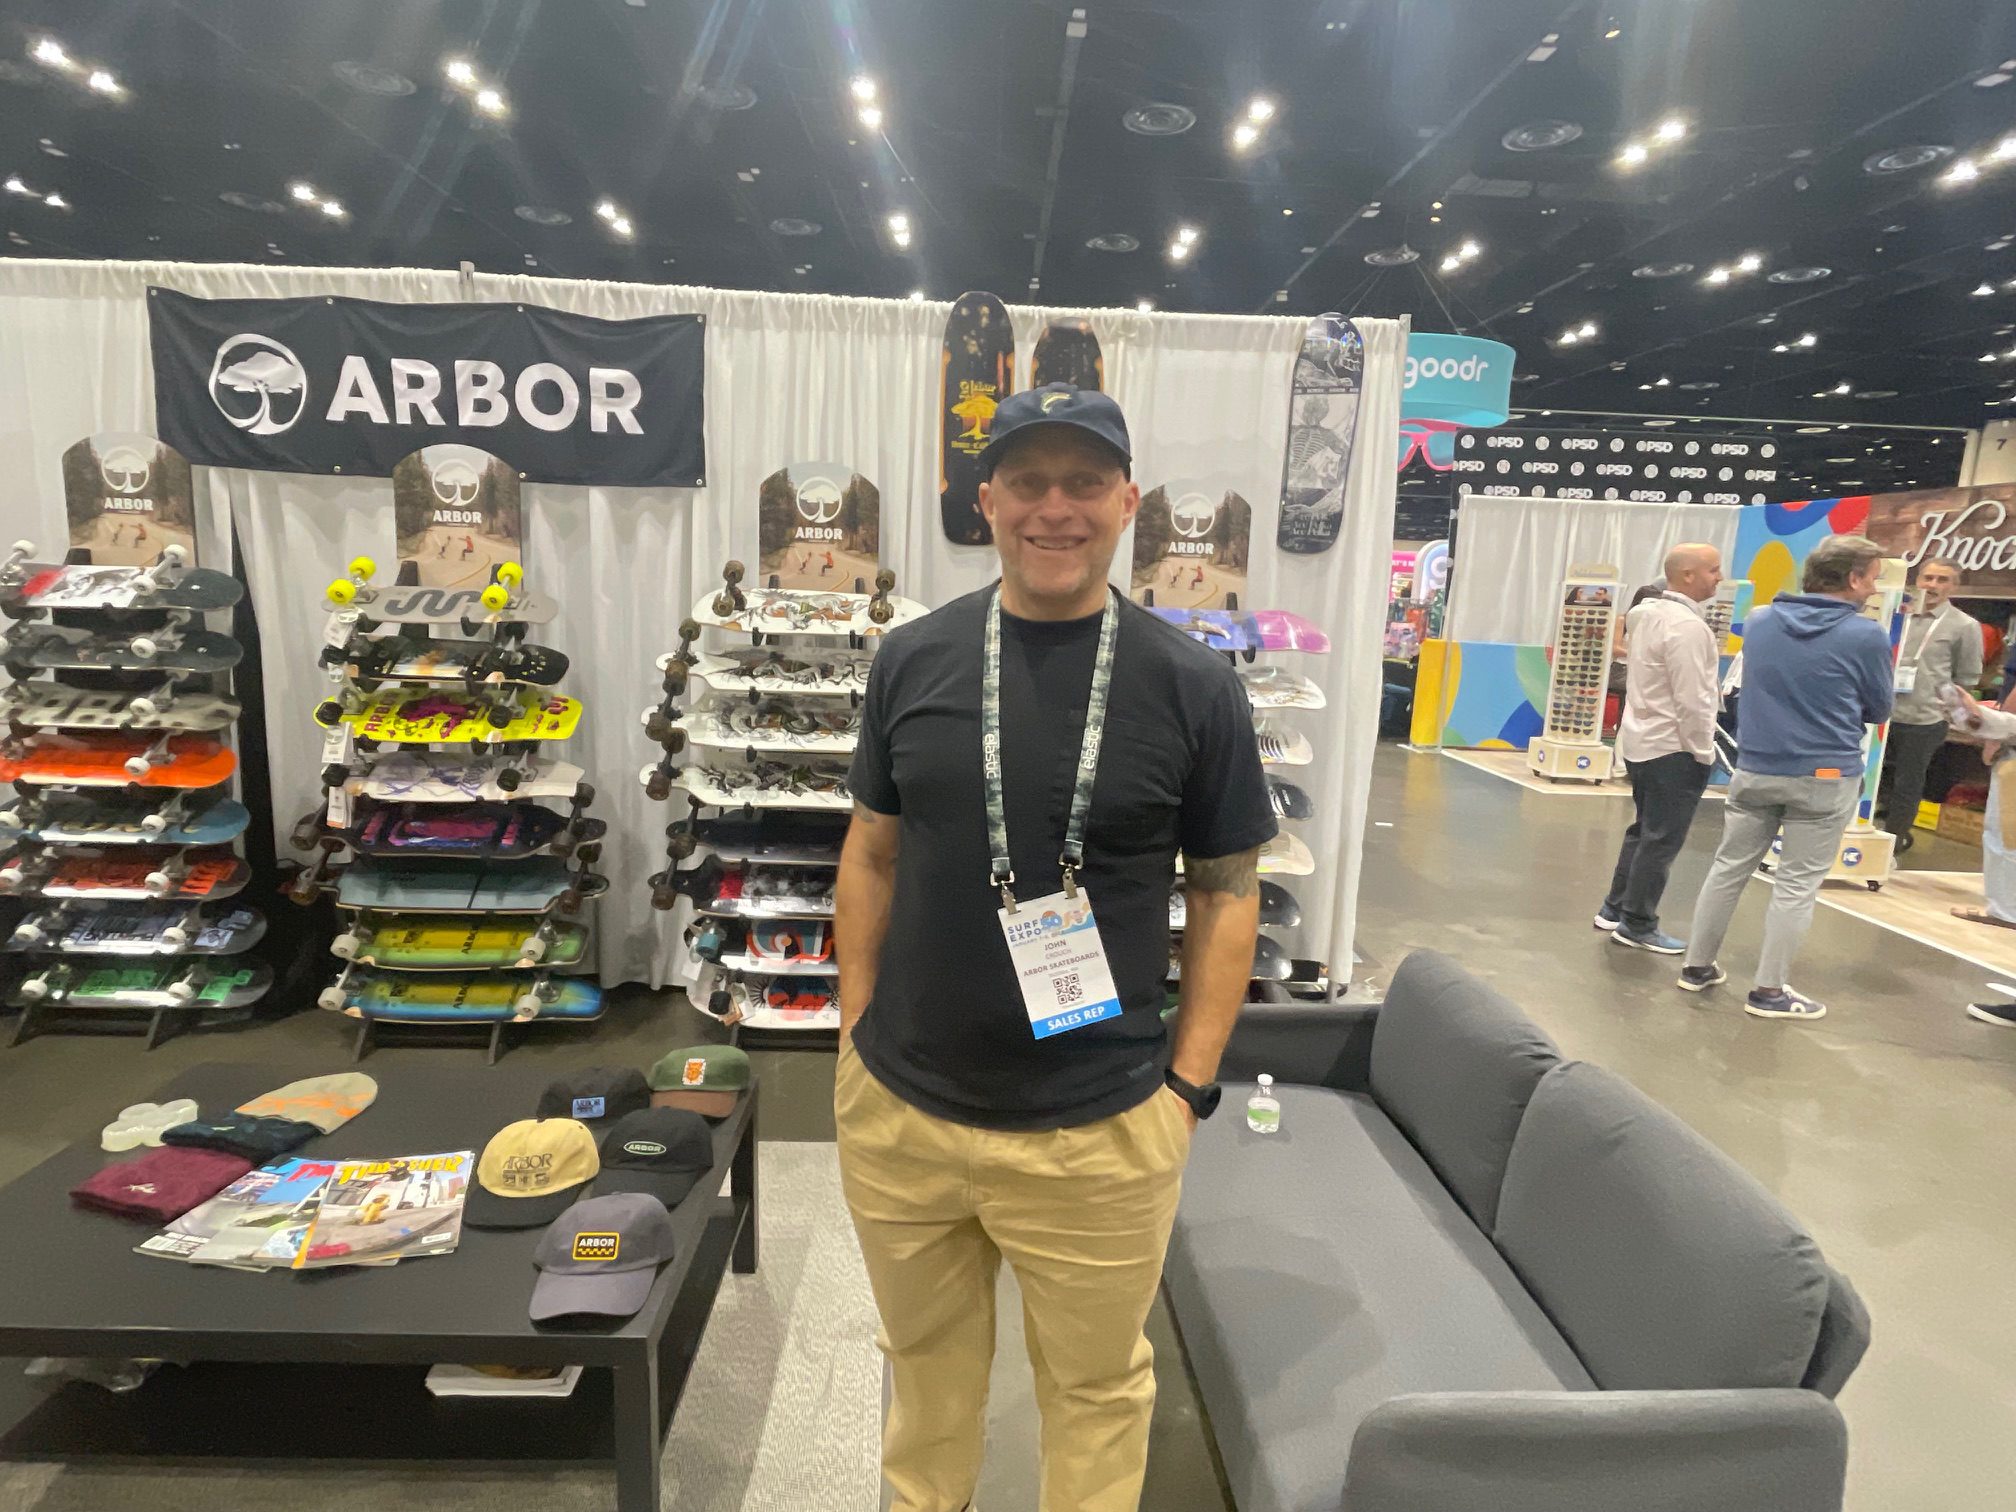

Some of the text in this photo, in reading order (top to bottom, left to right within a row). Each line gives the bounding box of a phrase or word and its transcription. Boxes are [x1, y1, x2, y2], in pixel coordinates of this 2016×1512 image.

[1404, 354, 1489, 390] goodr
[326, 354, 644, 435] ARBOR
[1497, 436, 1524, 448] PSD
[1571, 438, 1599, 450] PSD
[1646, 440, 1674, 453] PSD
[1997, 438, 2008, 451] 7
[1721, 443, 1749, 456] PSD
[1459, 460, 1485, 472] PSD
[1532, 462, 1559, 474] PSD
[1606, 464, 1633, 476] PSD
[1680, 466, 1707, 479] PSD
[104, 496, 154, 511] ARBOR
[433, 509, 482, 524] ARBOR
[795, 526, 843, 540] ARBOR
[1168, 541, 1215, 555] ARBOR
[1083, 724, 1101, 770] elastic
[984, 733, 999, 780] elastic
[1007, 919, 1039, 934] SURF
[1009, 927, 1042, 942] EXPO
[1044, 939, 1067, 951] JOHN
[1023, 965, 1048, 977] ARBOR
[1049, 951, 1100, 970] SKATEBOARDS
[1047, 1006, 1105, 1031] SALES REP
[627, 1143, 662, 1152] ARBOR
[503, 1153, 553, 1173] ARBOR
[578, 1237, 615, 1247] ARBOR
